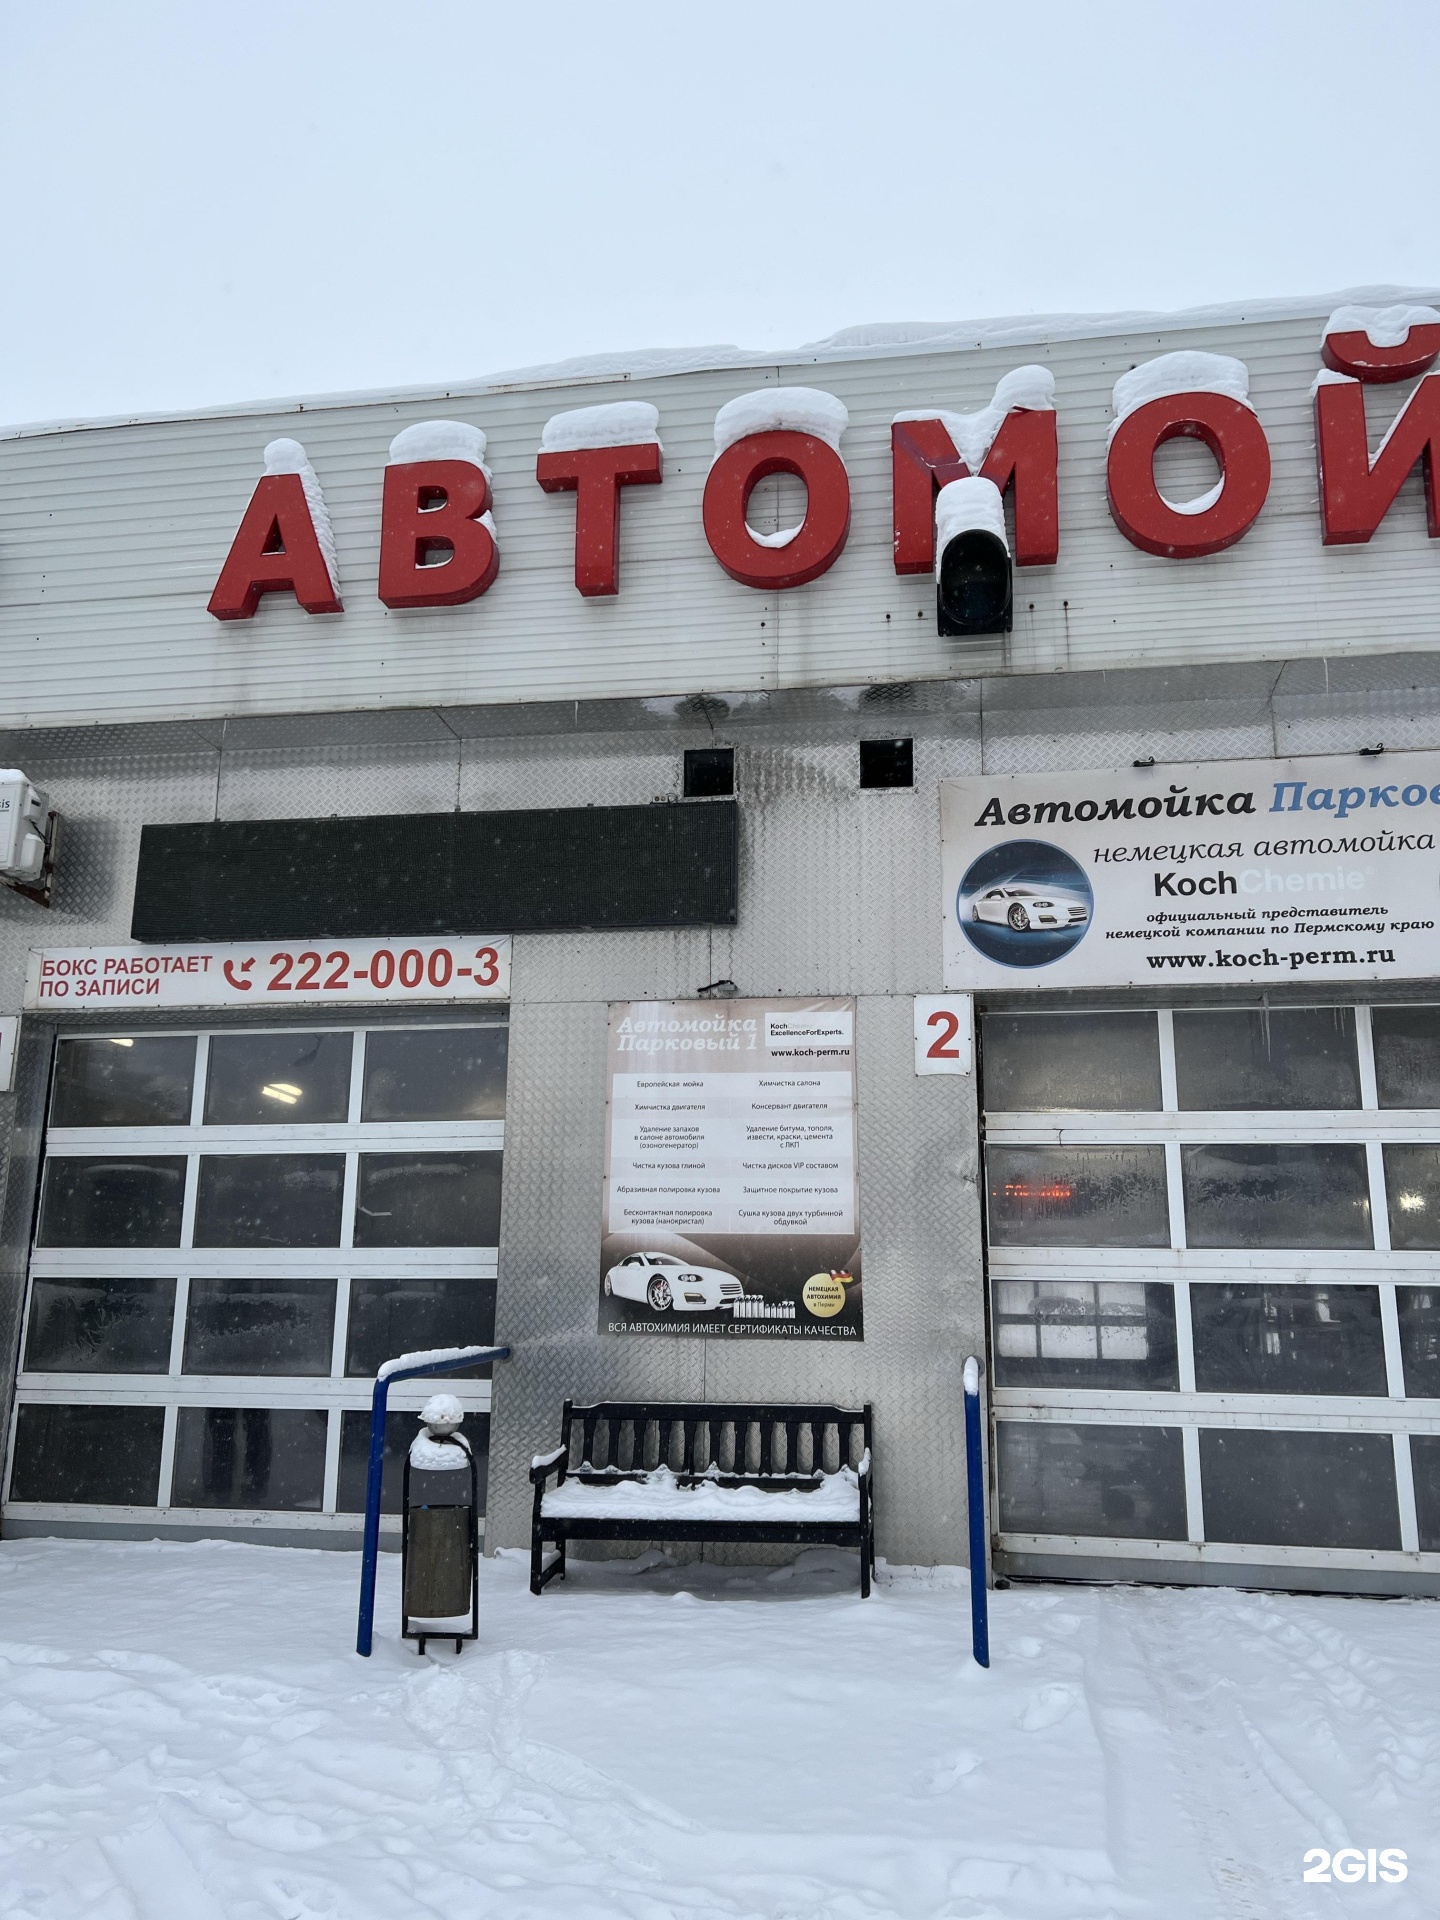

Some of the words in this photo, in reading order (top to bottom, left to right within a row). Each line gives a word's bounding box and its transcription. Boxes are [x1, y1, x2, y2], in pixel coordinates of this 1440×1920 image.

[974, 784, 1256, 828] Автомойка
[1093, 839, 1245, 865] немецкая
[1253, 829, 1436, 858] автомойка
[1146, 906, 1256, 924] официальный
[1262, 903, 1389, 920] представитель
[1105, 926, 1181, 941] немецкой
[1185, 923, 1267, 938] компании
[1271, 924, 1288, 935] по
[1293, 921, 1386, 936] Пермскому
[1389, 919, 1435, 933] краю
[41, 958, 98, 977] БОКС
[103, 956, 213, 975] РАБОТАЕТ
[1146, 948, 1396, 970] www.koch-perm.ru
[267, 947, 499, 991] 222-000-3
[39, 980, 69, 996] ПО
[74, 978, 160, 996] ЗАПИСИ
[617, 1013, 758, 1033] Автомойка
[926, 1010, 960, 1059] 2
[617, 1034, 742, 1056] Парковый
[747, 1034, 758, 1050] 1
[771, 1048, 850, 1057] www.koch-perm.ru
[637, 1080, 680, 1088] Европейская
[683, 1080, 704, 1088] мойка
[746, 1125, 778, 1133] Удаление
[779, 1125, 807, 1133] битума,
[639, 1141, 699, 1150] (озоногенератор)
[659, 1187, 696, 1195] полировка
[742, 1186, 777, 1194] Защитное
[779, 1187, 814, 1195] покрытие
[656, 1217, 704, 1225] (нанокристал)
[774, 1218, 808, 1227] обдувкой
[787, 1211, 804, 1219] двух
[805, 1210, 843, 1218] турбинной
[608, 1323, 628, 1332] ВСЯ
[629, 1323, 690, 1333] АВТОХИМИЯ
[692, 1324, 726, 1333] ИМЕЕТ
[728, 1325, 801, 1335] СЕРТИФИКАТЫ
[804, 1326, 857, 1336] КАЧЕСТВА
